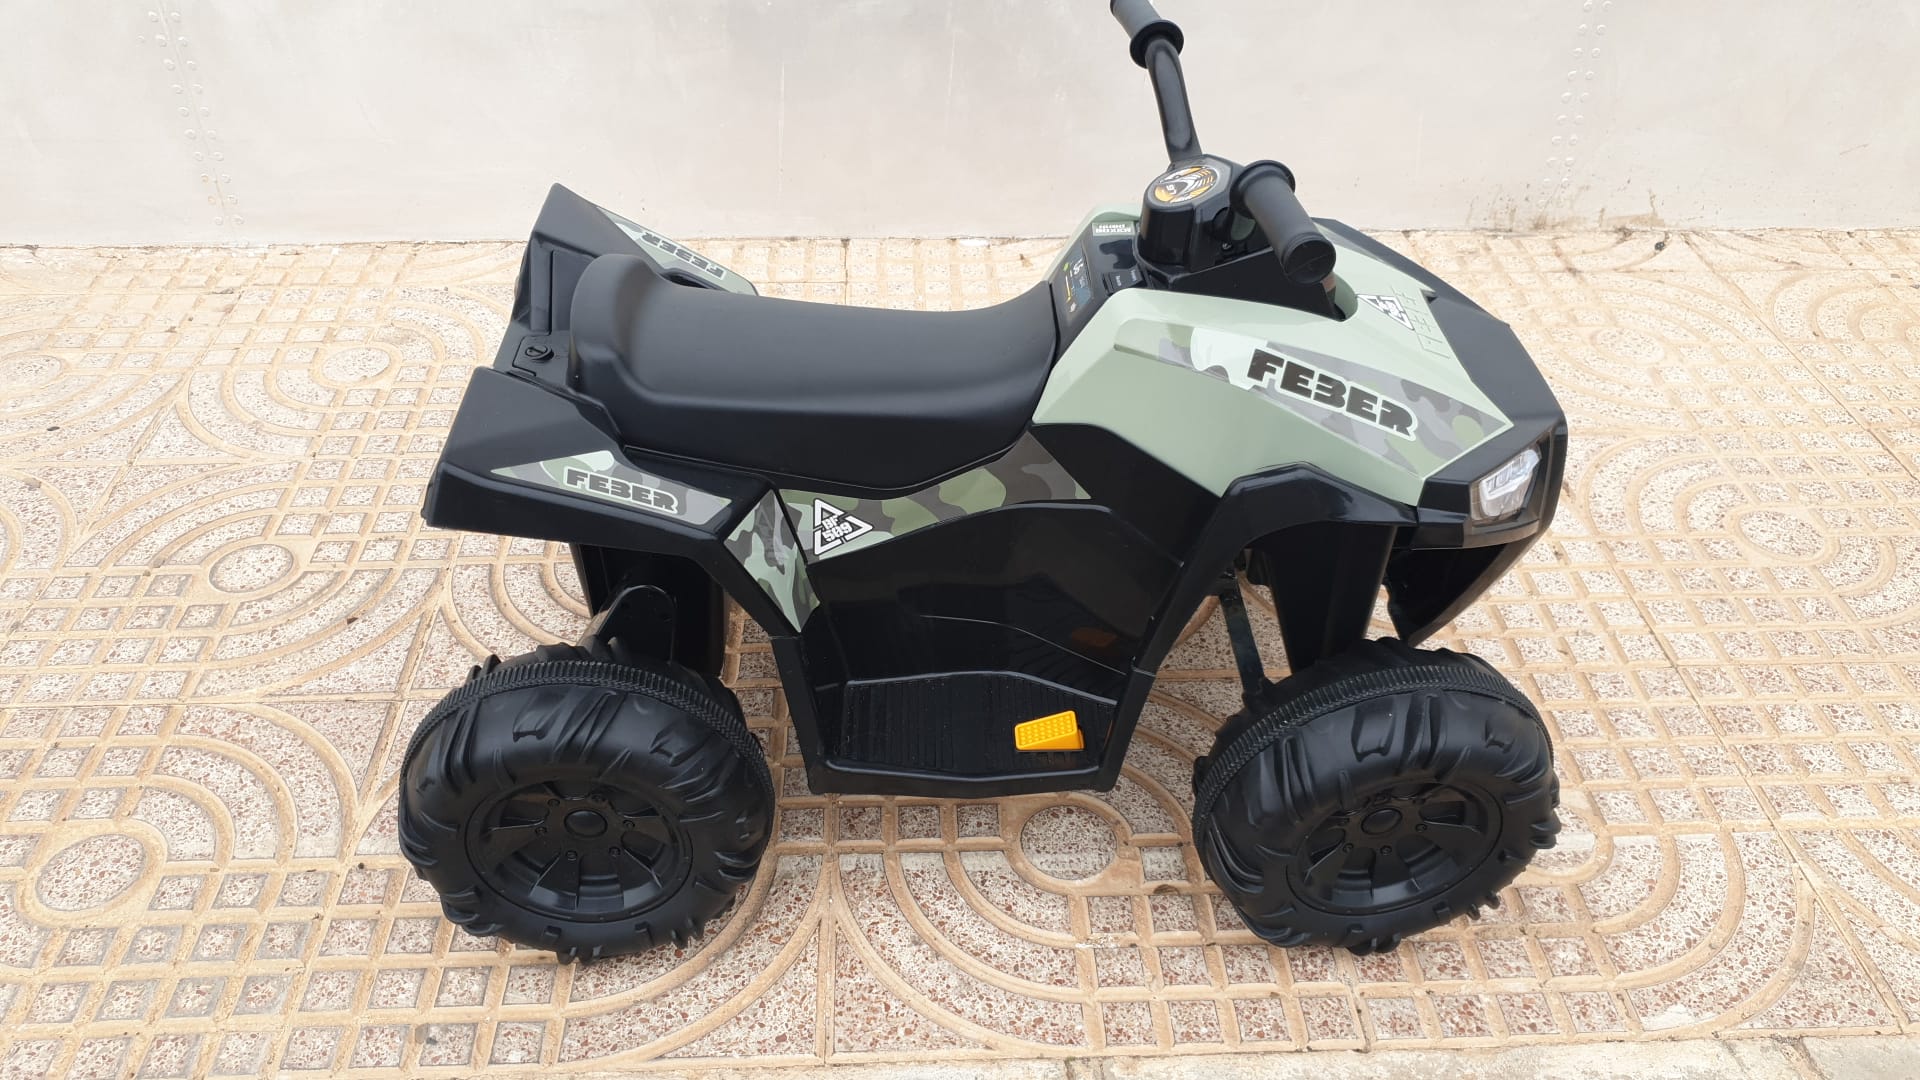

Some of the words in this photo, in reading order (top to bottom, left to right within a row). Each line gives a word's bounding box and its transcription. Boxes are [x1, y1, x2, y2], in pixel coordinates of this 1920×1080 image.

[641, 232, 725, 278] FEBER
[1246, 347, 1415, 437] FEBER
[566, 468, 676, 512] FEBER
[821, 514, 839, 530] BF
[822, 521, 853, 542] 509
